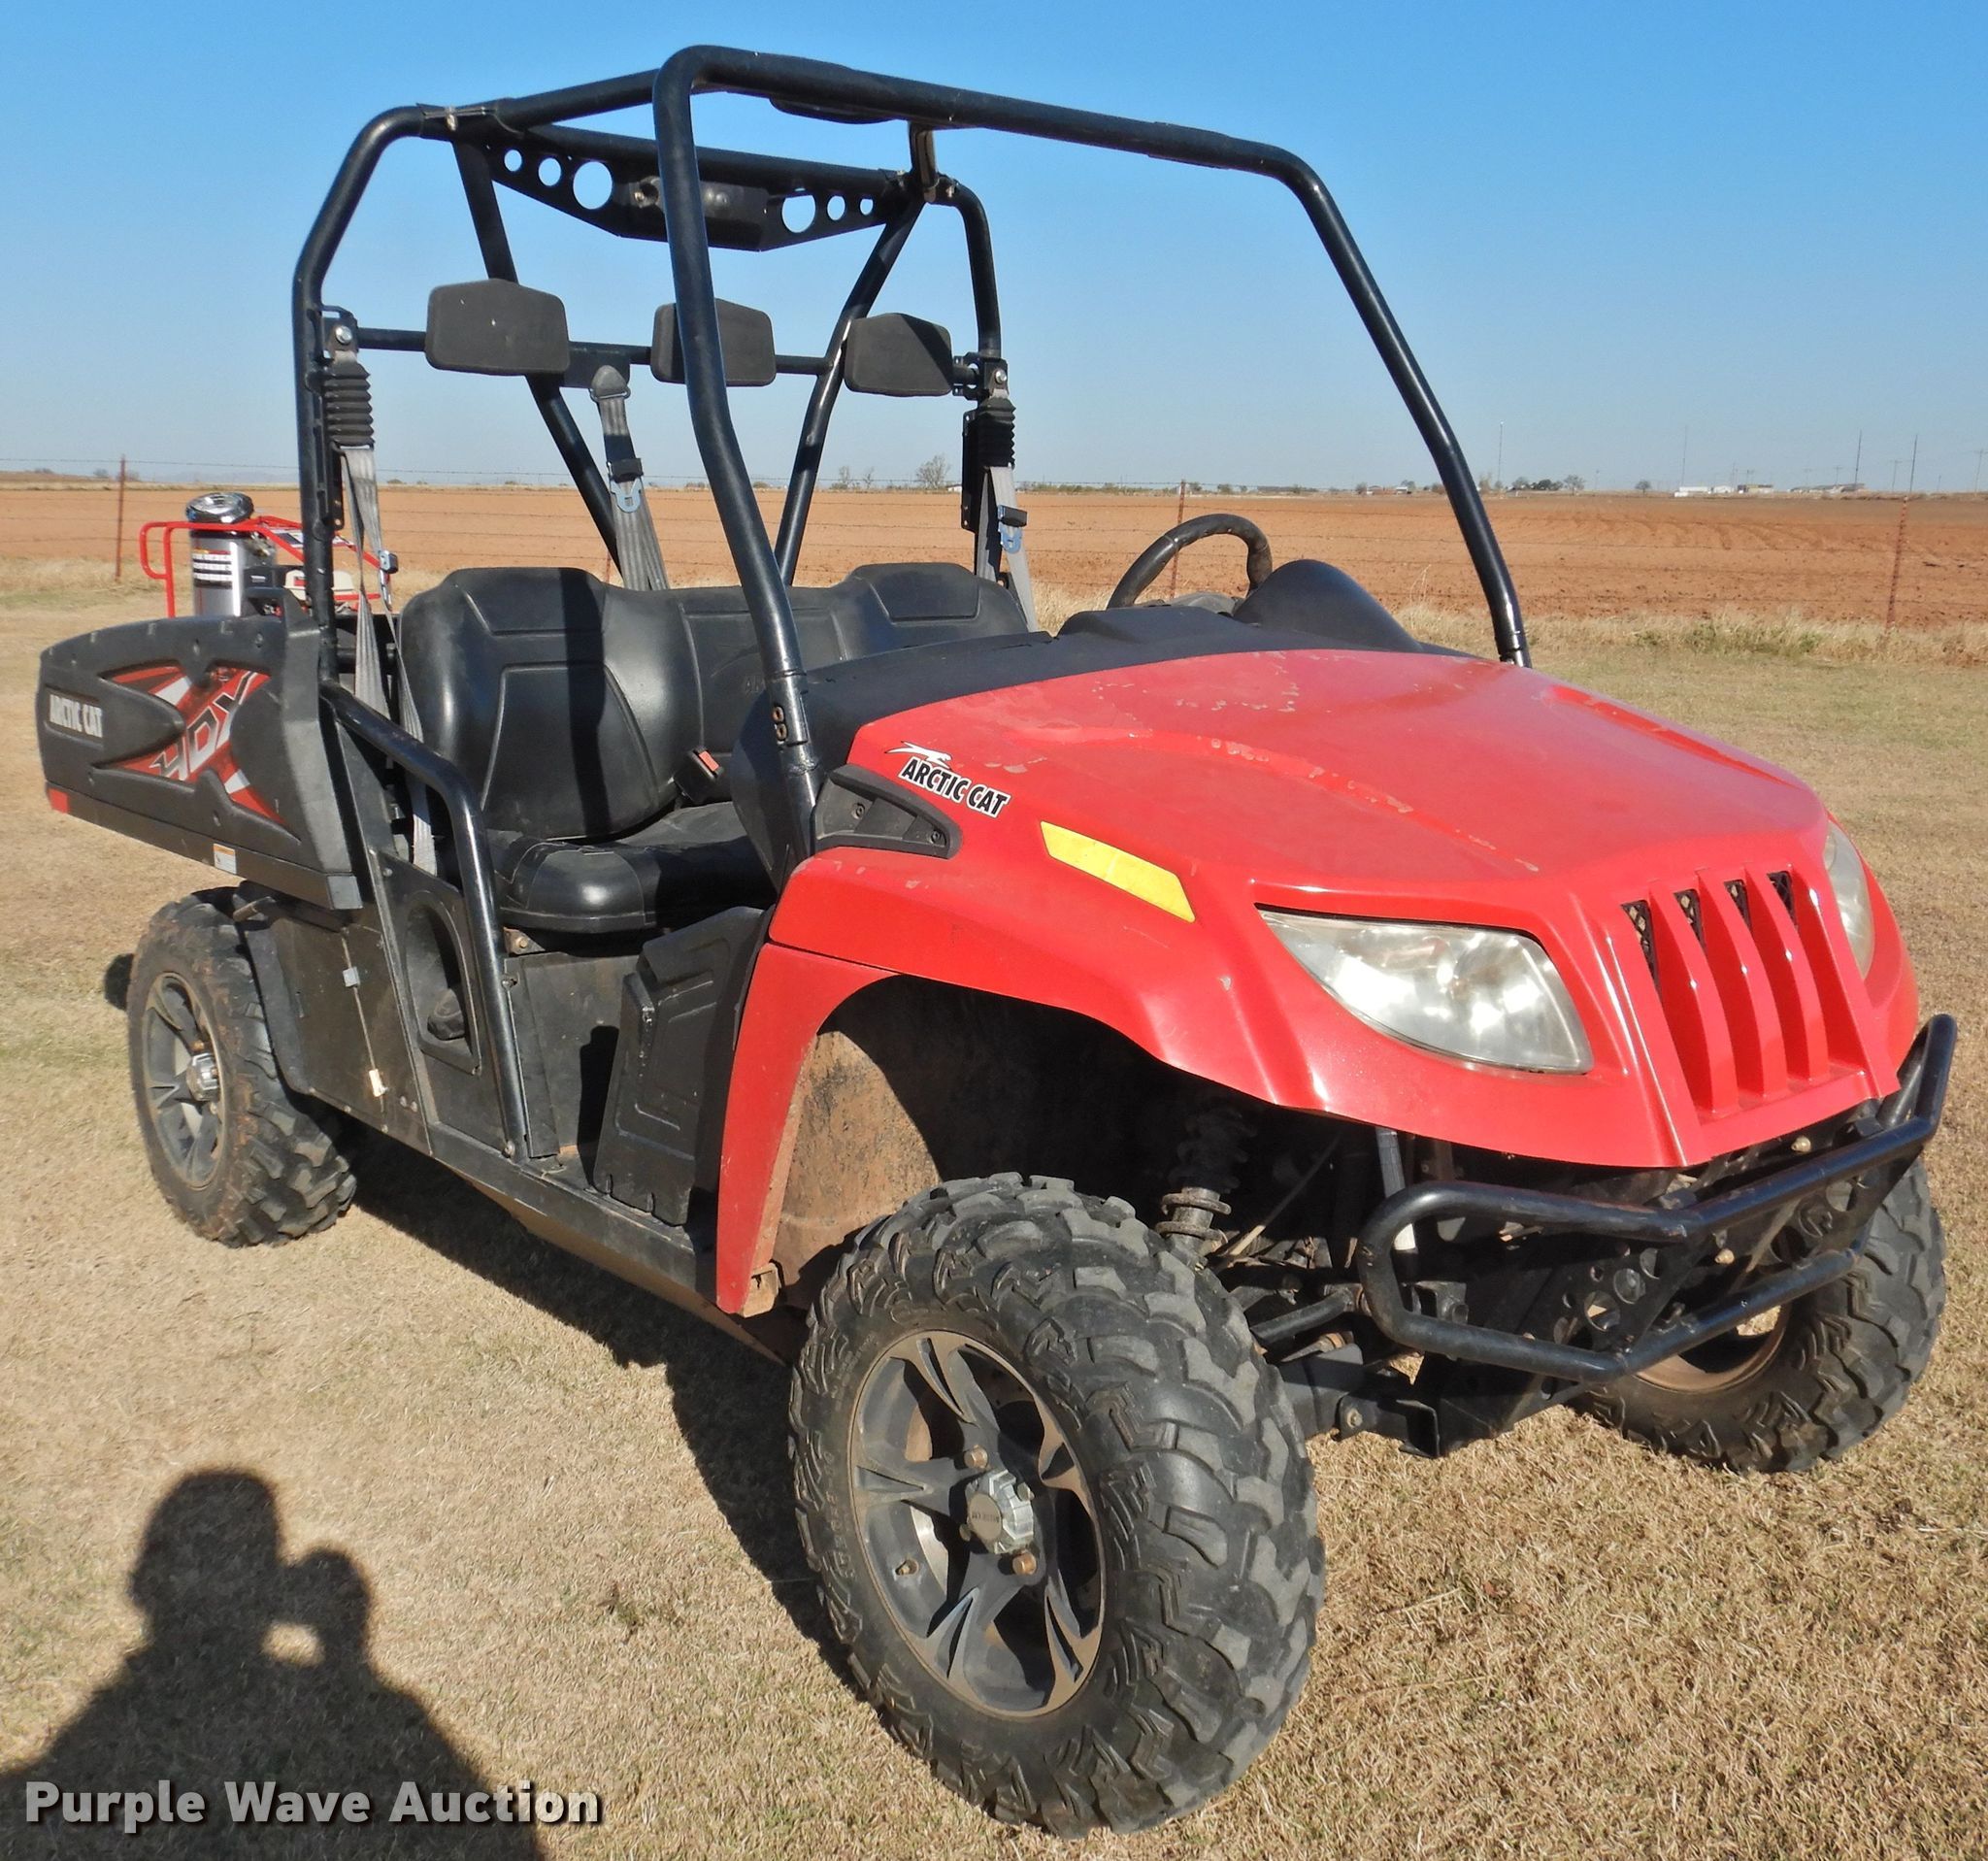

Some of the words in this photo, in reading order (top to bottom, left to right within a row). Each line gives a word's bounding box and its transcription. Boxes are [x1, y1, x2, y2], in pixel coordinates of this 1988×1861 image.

[50, 693, 83, 732] ARCTIC
[83, 703, 103, 738] CAT
[899, 757, 971, 803] ARCTIC
[967, 784, 1011, 818] CAT
